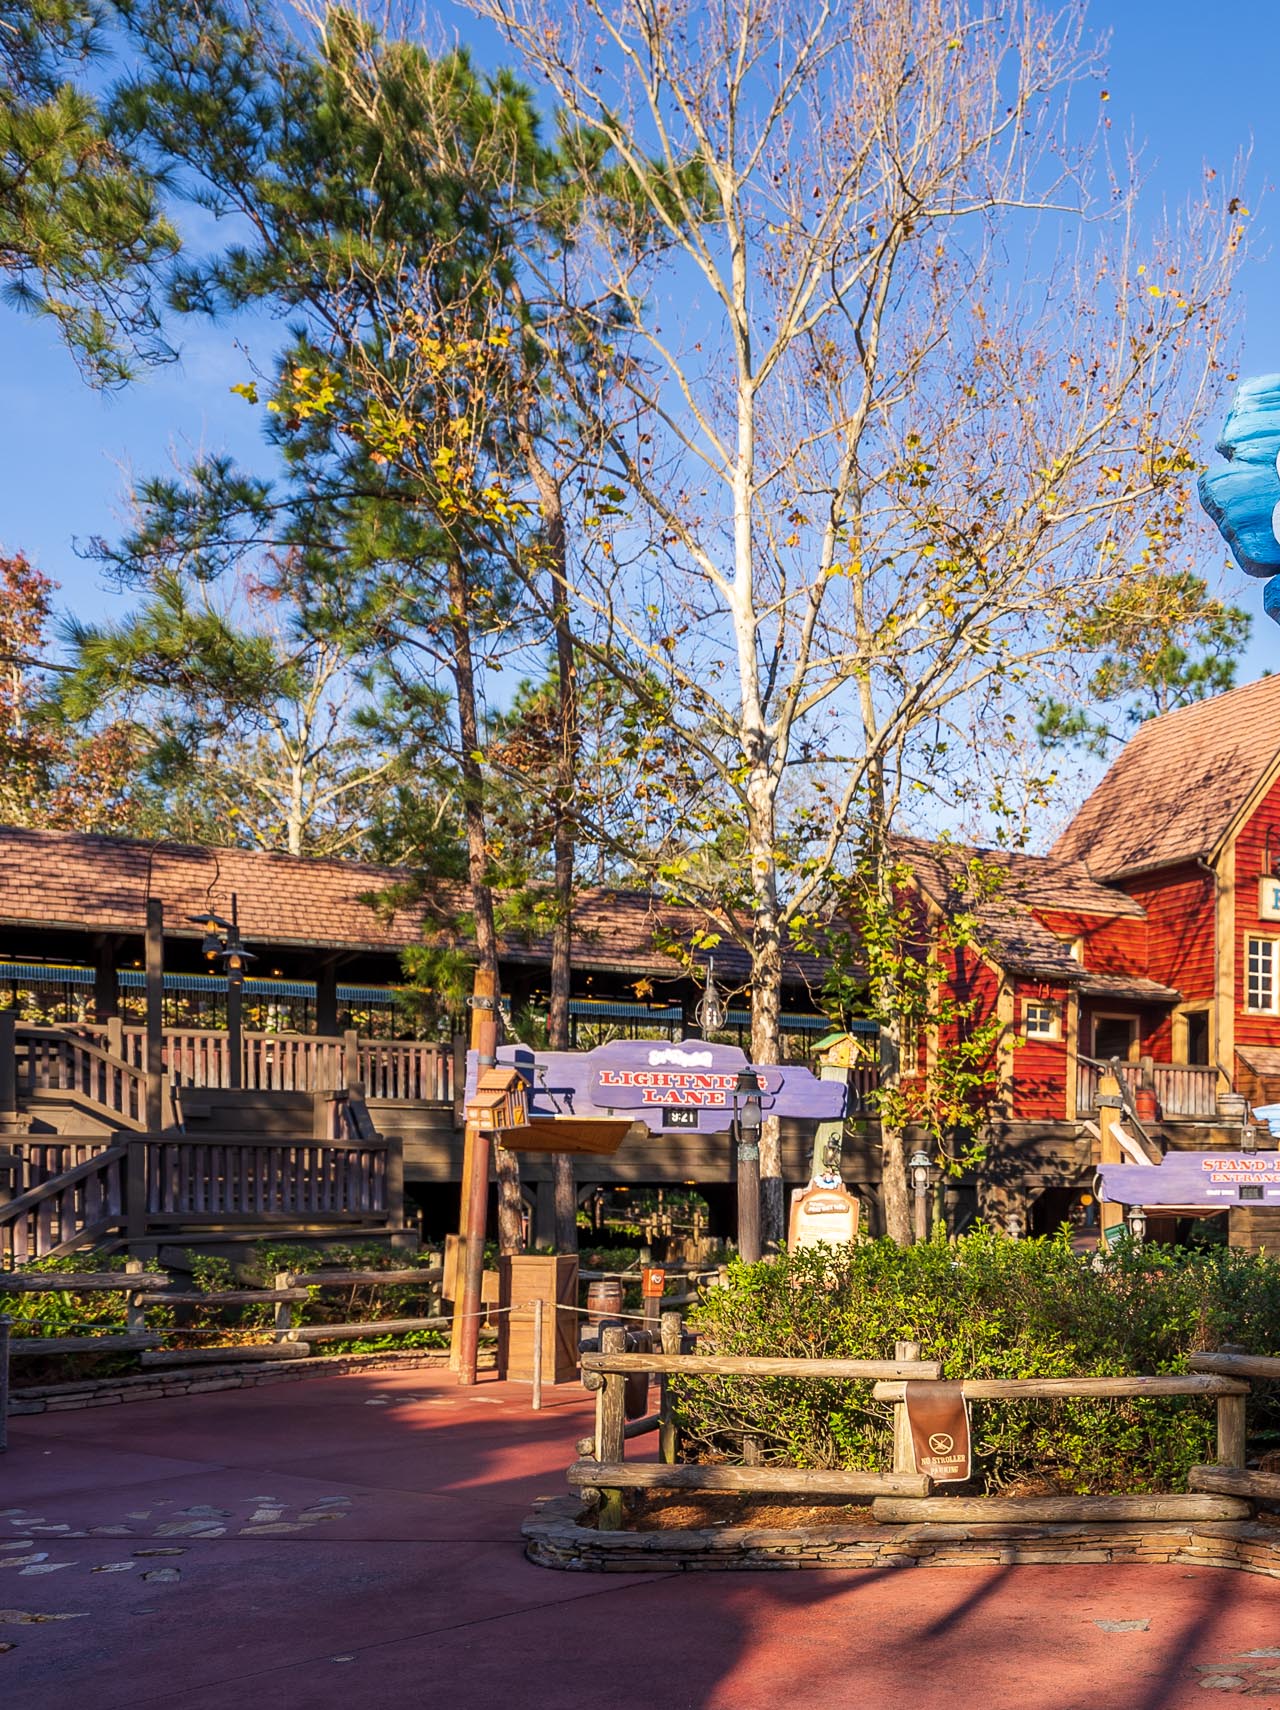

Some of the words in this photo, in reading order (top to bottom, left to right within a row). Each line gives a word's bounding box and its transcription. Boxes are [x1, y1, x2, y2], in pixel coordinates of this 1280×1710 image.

[642, 1089, 726, 1106] LANE
[921, 1457, 930, 1465] NO
[932, 1454, 966, 1464] STROLLER
[930, 1466, 958, 1474] PARKING
